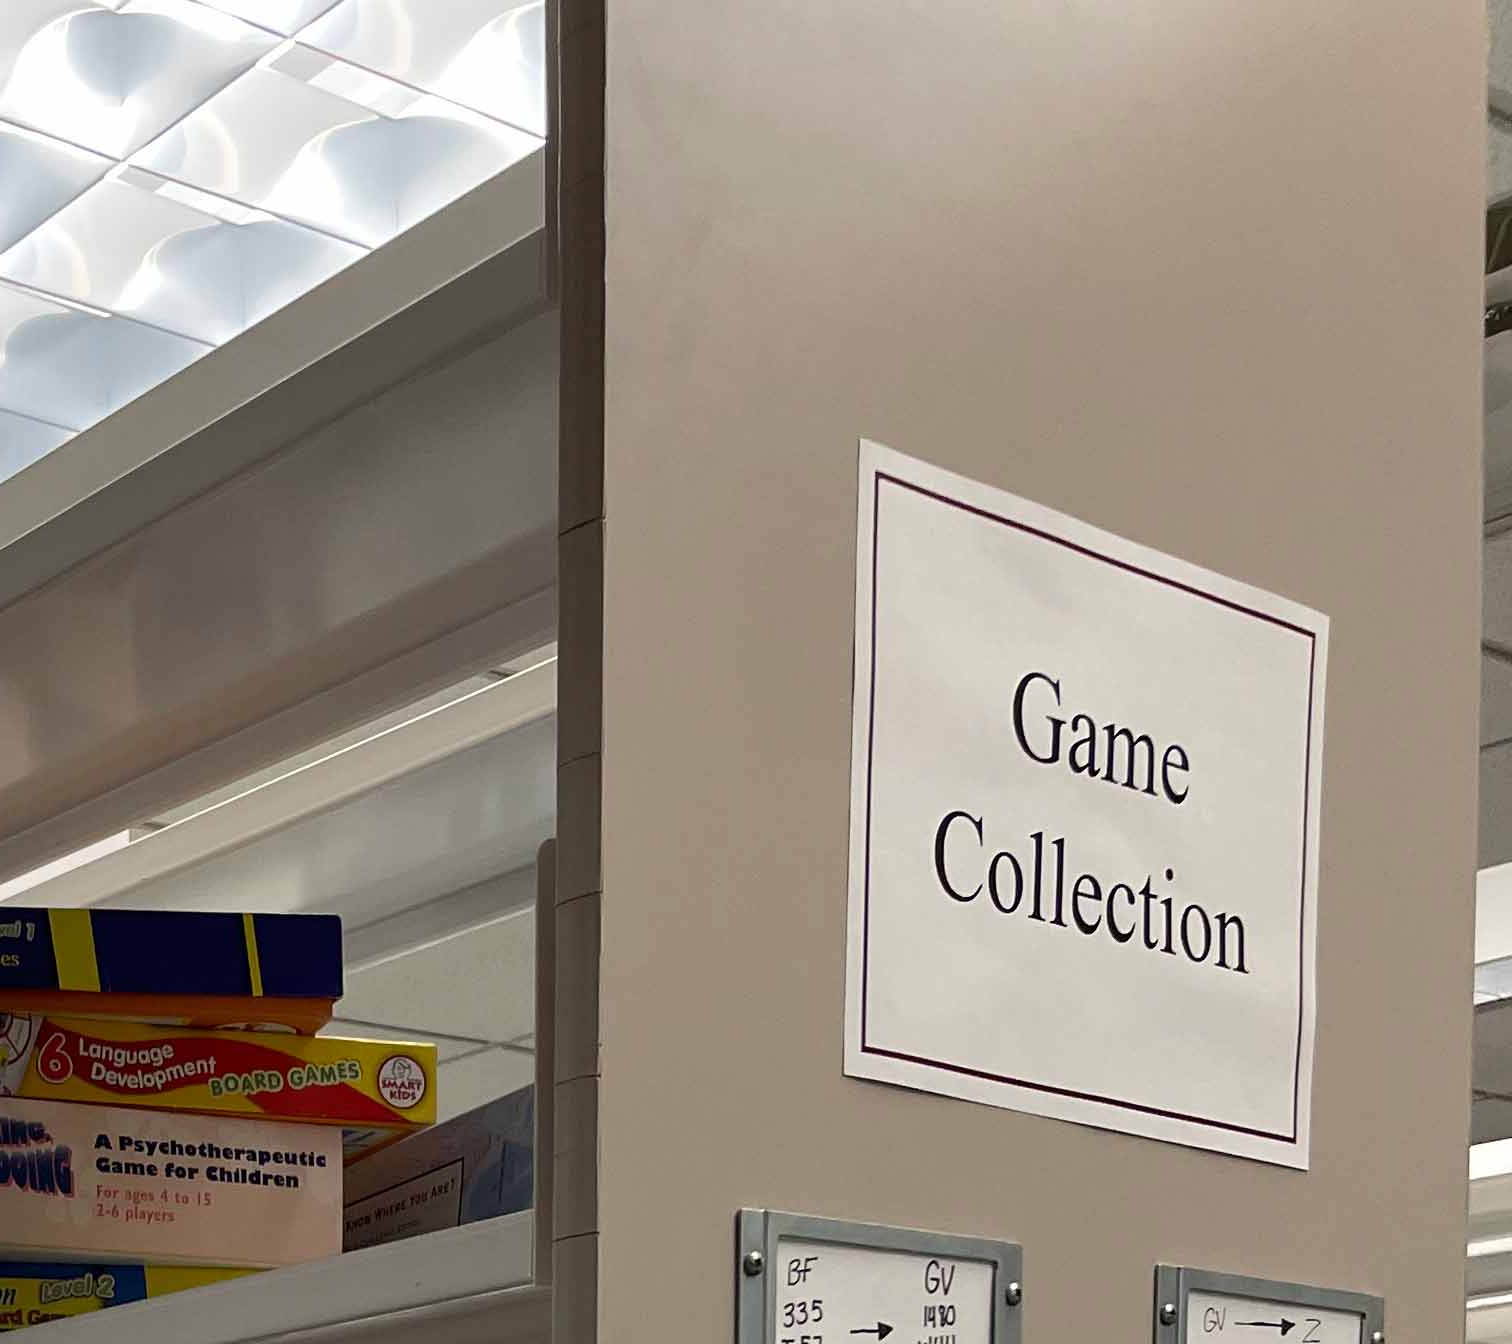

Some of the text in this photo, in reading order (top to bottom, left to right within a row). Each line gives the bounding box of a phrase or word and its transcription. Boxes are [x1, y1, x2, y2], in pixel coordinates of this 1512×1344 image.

[1011, 671, 1190, 804] Game
[934, 809, 1250, 976] Collection
[24, 921, 37, 942] 1
[38, 1032, 175, 1084] 6 Language
[90, 1056, 363, 1098] Development BOARD GAMES
[381, 1078, 424, 1092] SMART
[390, 1089, 418, 1102] KIDS
[94, 1133, 328, 1170] A Psychotherapeutic
[95, 1157, 300, 1190] Game for Children
[96, 1185, 213, 1207] For ages 4 to 15
[375, 1203, 407, 1222] WHERE
[410, 1192, 429, 1208] YOU
[96, 1203, 177, 1225] 2-6 players
[39, 1277, 94, 1304] Level
[95, 1273, 117, 1299] 2
[787, 1257, 955, 1297] BF GV
[782, 1299, 957, 1329] 335 1480
[1203, 1307, 1322, 1344] GV Z
